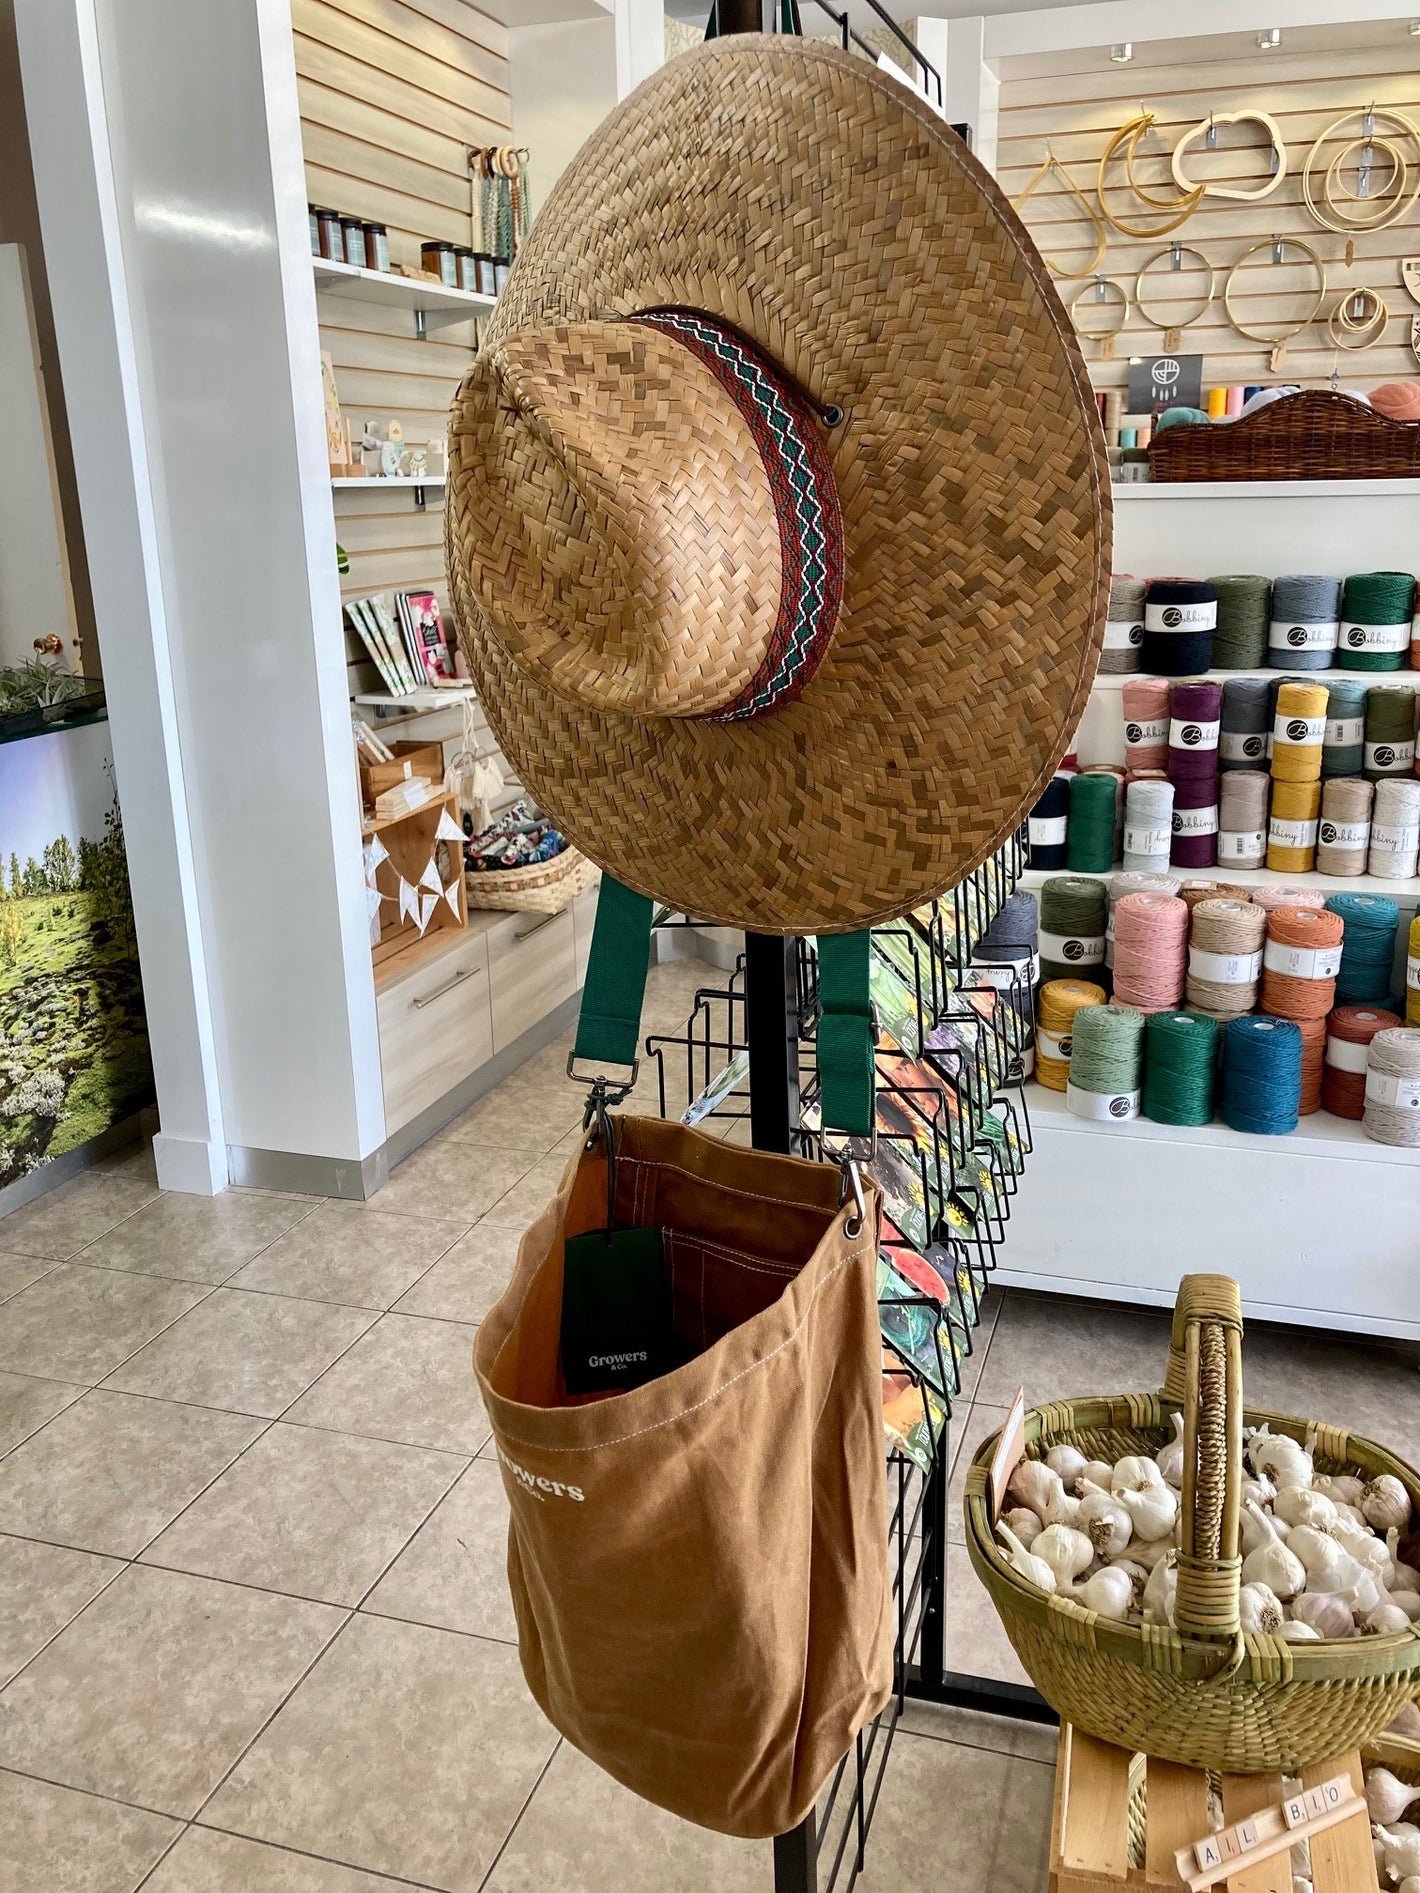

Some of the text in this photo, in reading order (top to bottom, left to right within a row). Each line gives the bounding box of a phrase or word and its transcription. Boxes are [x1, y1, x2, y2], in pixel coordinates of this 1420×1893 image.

[588, 1351, 648, 1368] Growers
[1205, 1786, 1340, 1864] AIL BIO
